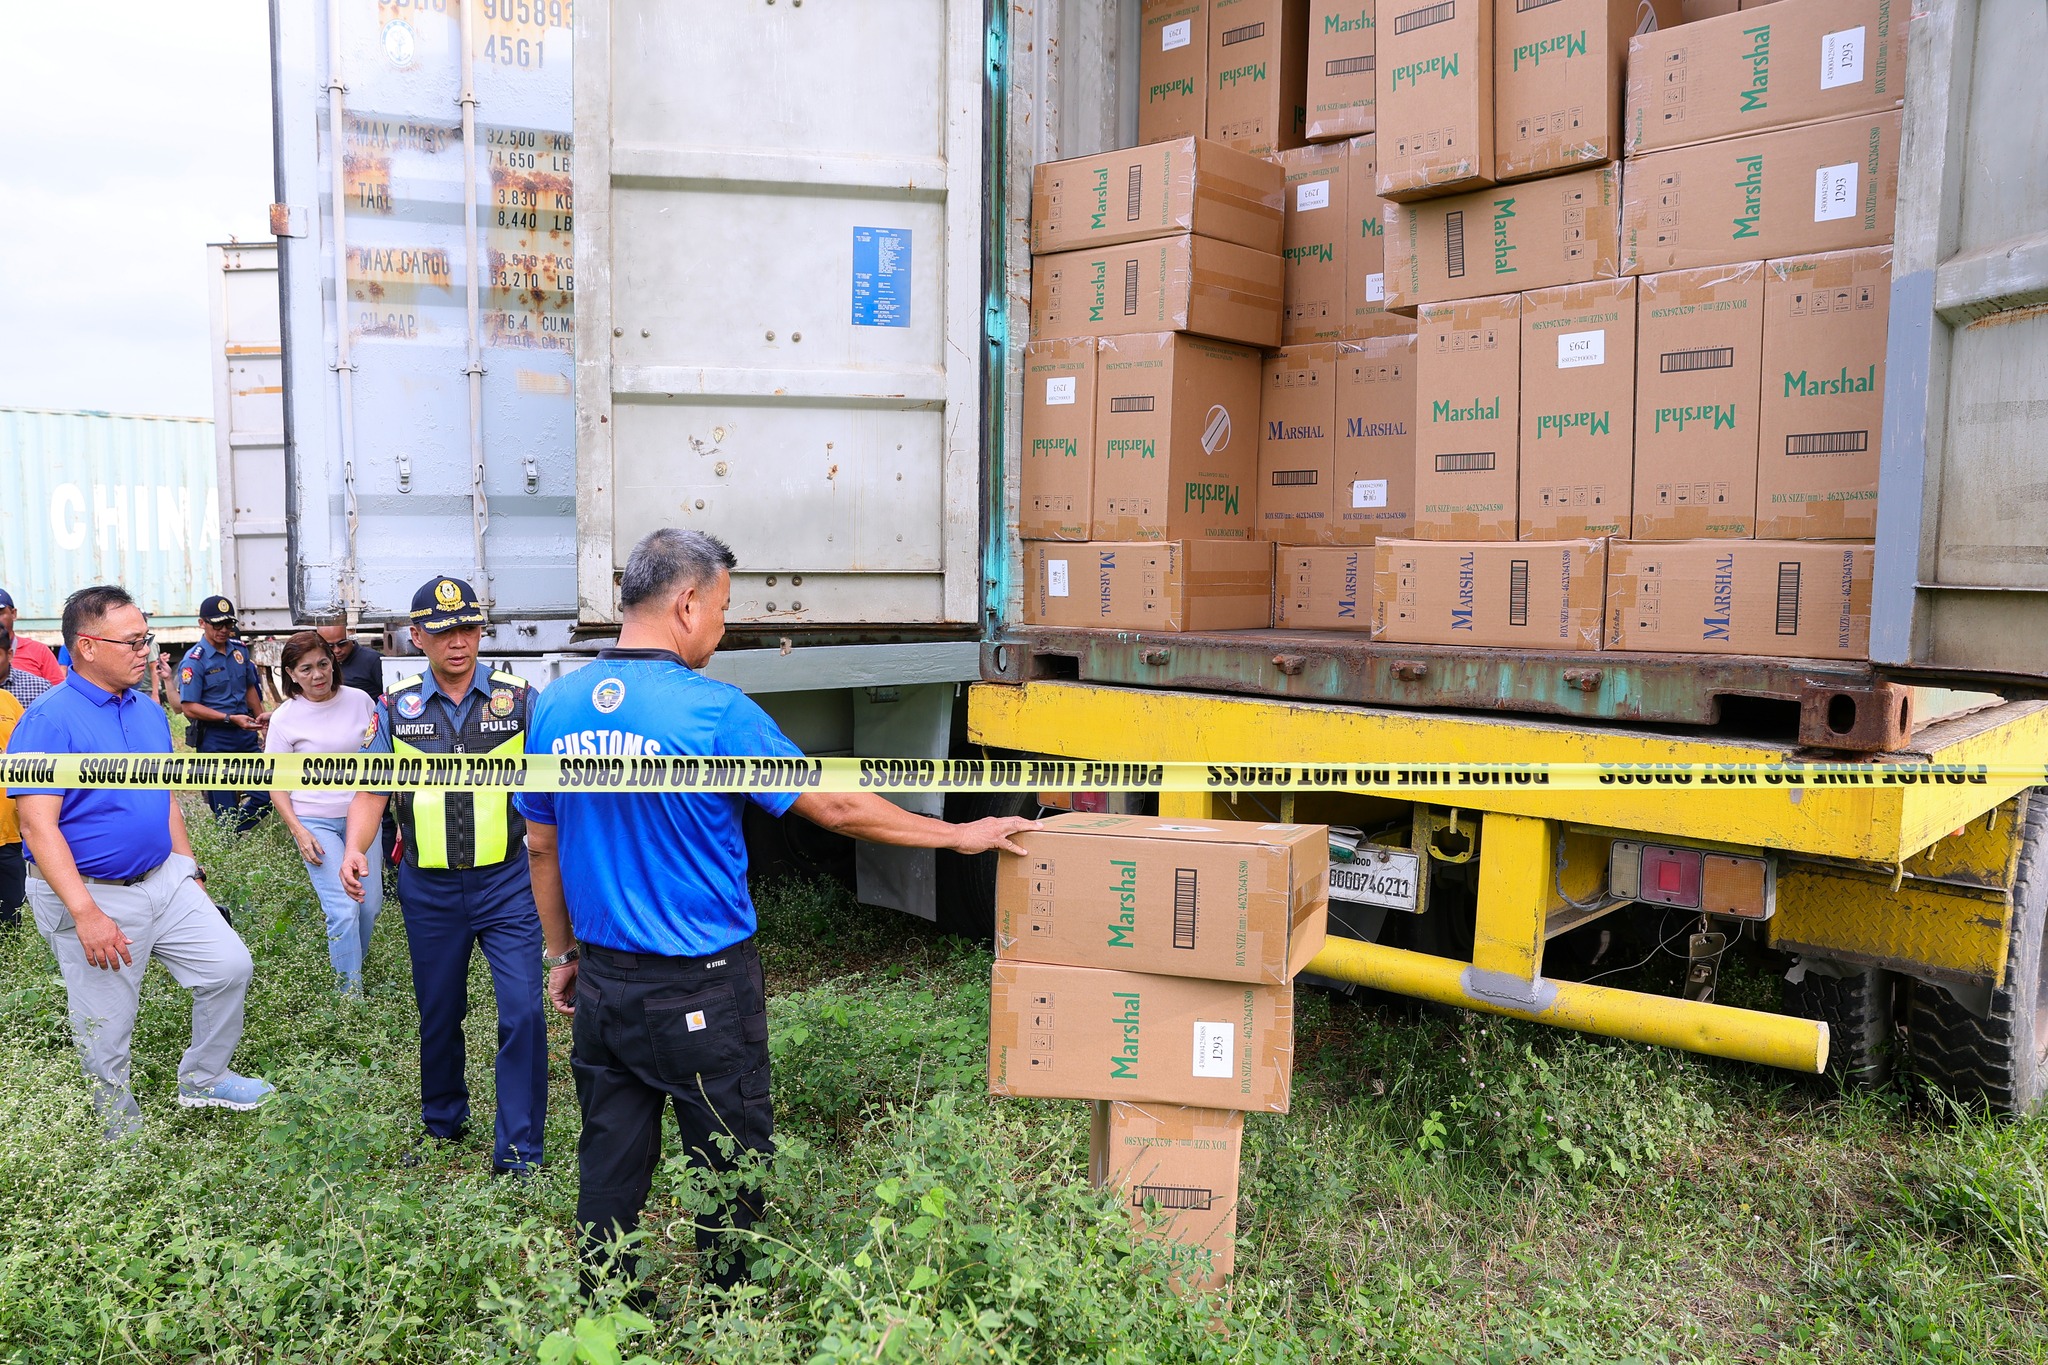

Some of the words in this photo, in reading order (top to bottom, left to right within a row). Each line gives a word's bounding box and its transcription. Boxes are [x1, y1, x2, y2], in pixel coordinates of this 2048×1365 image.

[1325, 10, 1375, 35] Marsha
[484, 34, 543, 69] 45G1
[1513, 30, 1588, 73] Marshal
[1842, 43, 1853, 68] J293
[1219, 62, 1267, 90] Marshal
[1392, 52, 1460, 92] Marshal
[1739, 24, 1771, 113] Marshal
[1150, 77, 1194, 104] Marshal
[1875, 78, 1886, 95] BOX
[553, 134, 571, 151] KG
[553, 156, 570, 172] LB
[555, 193, 573, 210] KG
[1091, 167, 1109, 230] Marshal
[1731, 154, 1763, 240] Marshal
[1835, 178, 1847, 203] J293
[555, 214, 573, 232] LB
[1493, 197, 1518, 275] Marshal
[1865, 214, 1876, 231] BOX
[555, 256, 573, 270] KG
[557, 274, 574, 291] LB
[1089, 261, 1106, 322] Marshal
[1604, 312, 1619, 322] BOX
[1730, 298, 1748, 309] BOX
[1569, 339, 1591, 351] J293
[1783, 364, 1876, 398] Marshal
[1433, 396, 1500, 423] Marshal
[1654, 403, 1736, 434] Marshal
[1268, 421, 1325, 441] MARSHAL
[1346, 417, 1407, 438] MARSHAL
[1537, 410, 1610, 439] Marshal
[1032, 438, 1078, 458] Marshal
[1107, 439, 1156, 459] Marshal
[1184, 482, 1240, 516] Marshal
[1425, 504, 1437, 513] BOX
[1771, 493, 1787, 504] BOX
[1826, 489, 1878, 501] 462X264X580
[50, 483, 220, 551] CHINA
[1338, 552, 1358, 618] MARSHAL
[1451, 551, 1474, 632] MARSHAL
[1703, 553, 1734, 642] MARSHAL
[1559, 625, 1569, 638] BOX
[1839, 633, 1849, 649] BOX
[395, 723, 435, 735] NARTATEZ
[480, 719, 519, 733] PULIS
[8, 757, 57, 784] POLICE
[78, 757, 128, 784] CROSS
[129, 757, 159, 785] NOT
[161, 757, 183, 785] DO
[185, 757, 219, 785] LINE
[220, 758, 276, 786] POLICE
[301, 757, 358, 786] CROSS
[359, 757, 395, 786] NOT
[397, 758, 422, 786] DO
[425, 758, 463, 786] LINE
[465, 758, 527, 787] POLICE
[558, 758, 624, 787] CROSS
[626, 758, 667, 787] NOT
[674, 758, 700, 787] DO
[703, 758, 748, 787] LINE
[751, 758, 822, 787] POLICE
[859, 759, 933, 787] CROSS
[938, 759, 984, 787] NOT
[990, 760, 1020, 787] DO
[1026, 761, 1075, 787] LINE
[1081, 763, 1163, 786] POLICE
[1237, 860, 1249, 910] 462X264X580
[1107, 859, 1137, 949] Marshal
[711, 959, 727, 968] STEEL
[1235, 951, 1247, 968] BOX
[1243, 990, 1255, 1039] 462X264X580
[1110, 991, 1141, 1080] Marshal
[1212, 1036, 1224, 1062] J293
[1241, 1079, 1251, 1095] BOX
[1211, 1140, 1227, 1150] BOX
